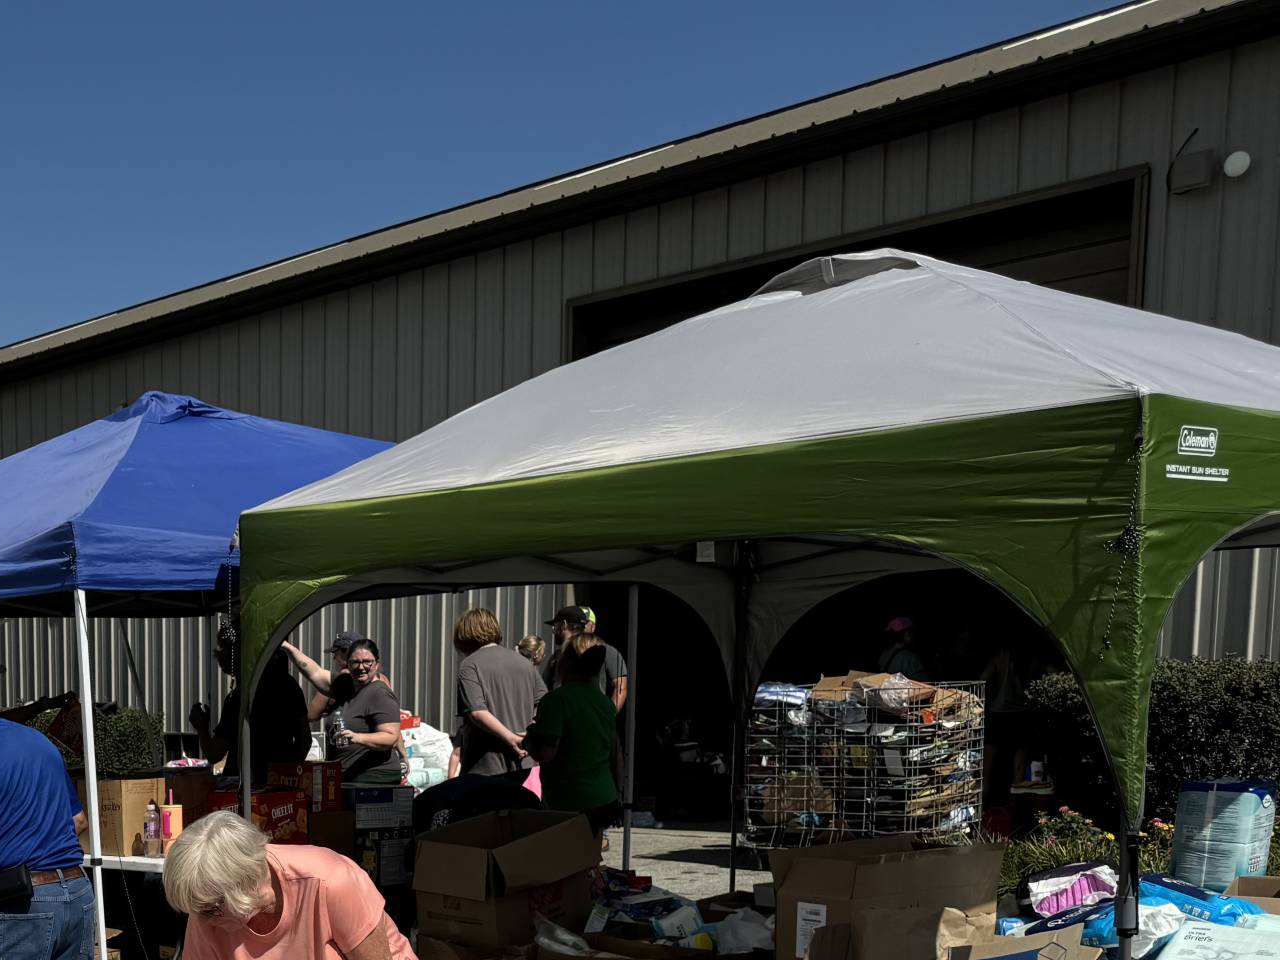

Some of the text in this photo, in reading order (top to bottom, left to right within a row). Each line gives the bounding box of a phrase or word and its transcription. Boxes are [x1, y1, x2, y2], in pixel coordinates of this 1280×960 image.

[1181, 429, 1209, 448] Coleman
[1166, 464, 1229, 476] INSTANT SUN SHELTER
